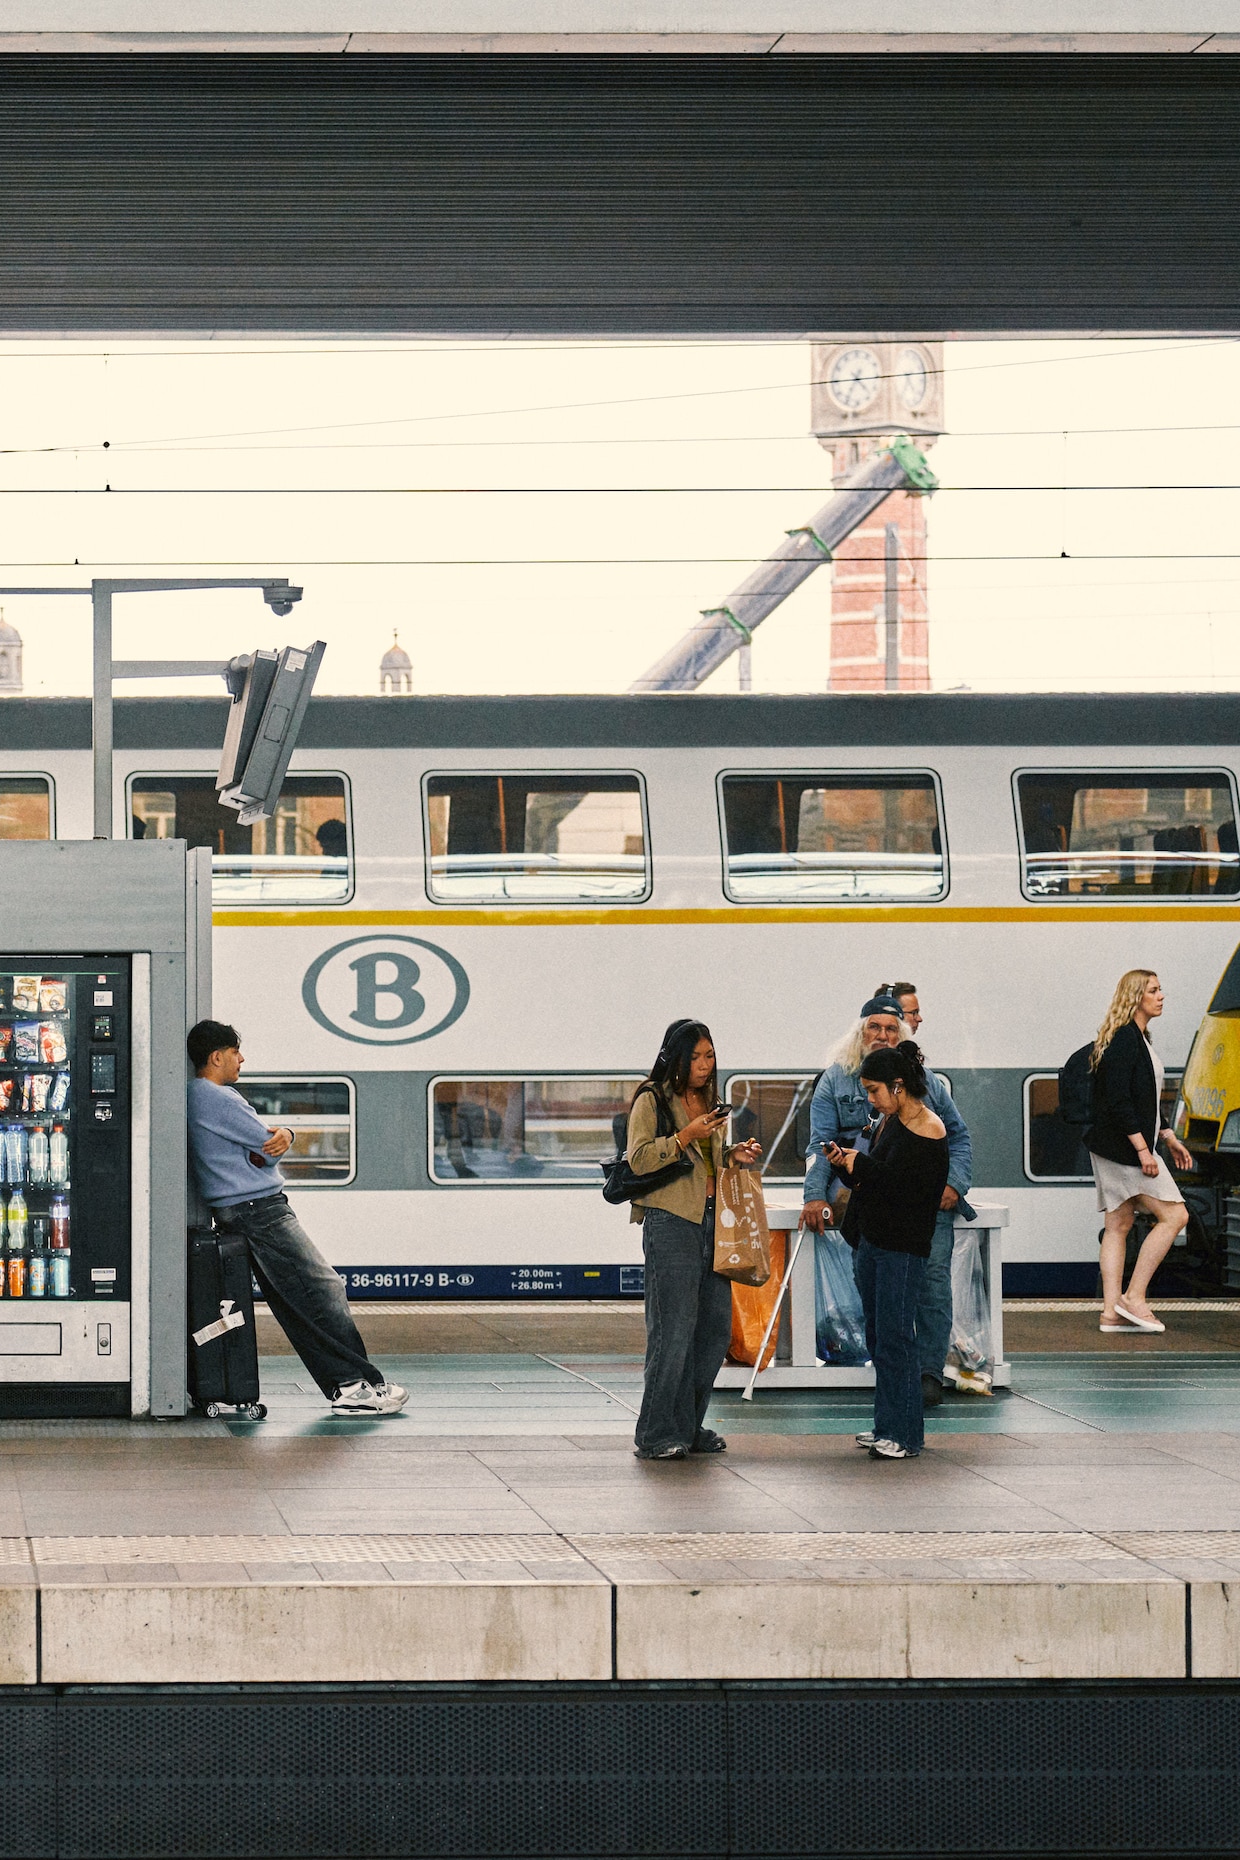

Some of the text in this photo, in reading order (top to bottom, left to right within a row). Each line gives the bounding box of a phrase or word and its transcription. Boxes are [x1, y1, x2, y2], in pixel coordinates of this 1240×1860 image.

[348, 952, 426, 1029] B
[351, 1273, 434, 1288] 36-96117-9
[518, 1268, 553, 1278] 20.00m
